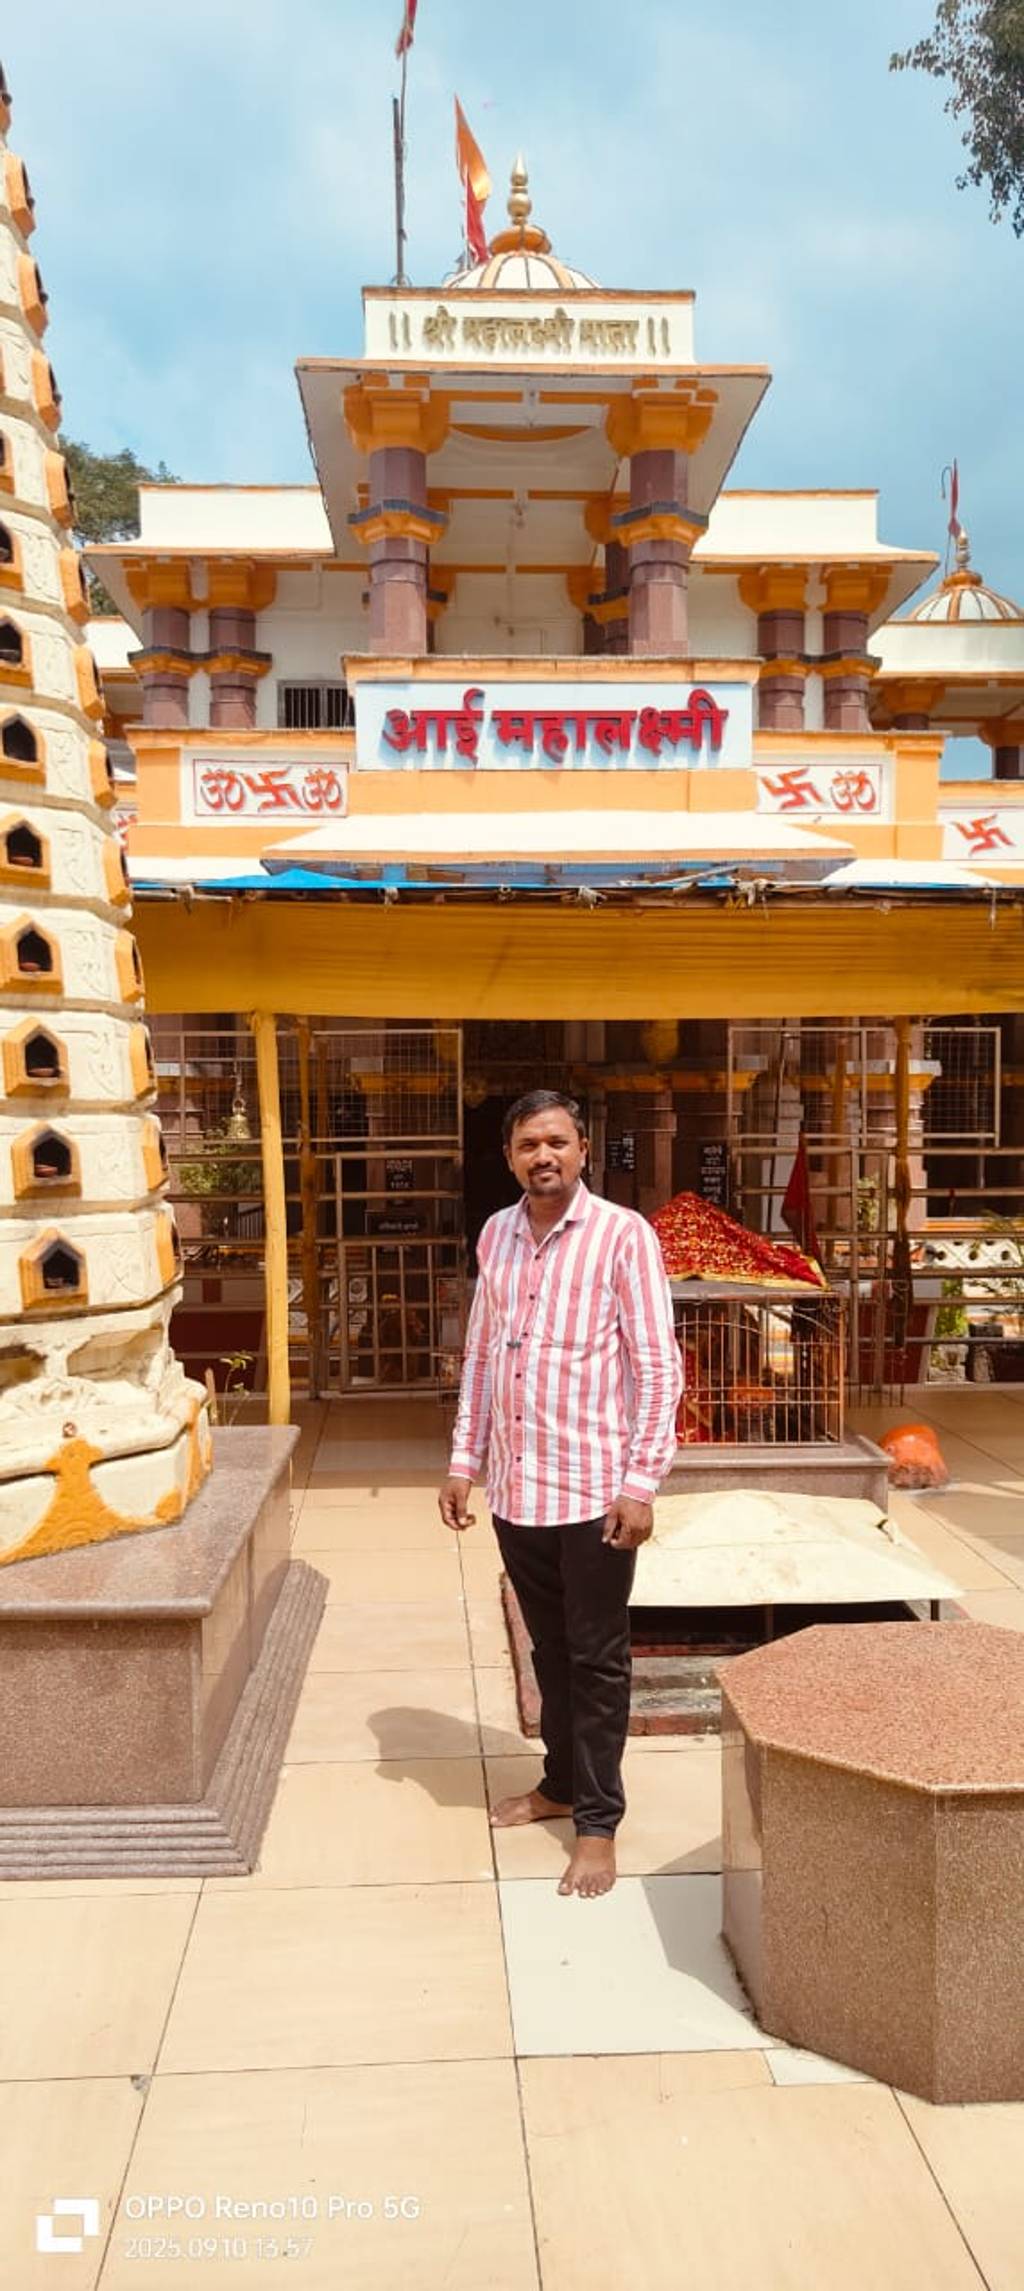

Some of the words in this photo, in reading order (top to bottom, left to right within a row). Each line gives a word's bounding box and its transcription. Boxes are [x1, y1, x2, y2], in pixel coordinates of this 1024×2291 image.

[422, 305, 457, 351] श्री
[462, 307, 576, 354] महालक्ष्मी
[579, 319, 640, 357] माता
[382, 687, 485, 765] आई
[491, 688, 729, 763] महालक्ष्मी
